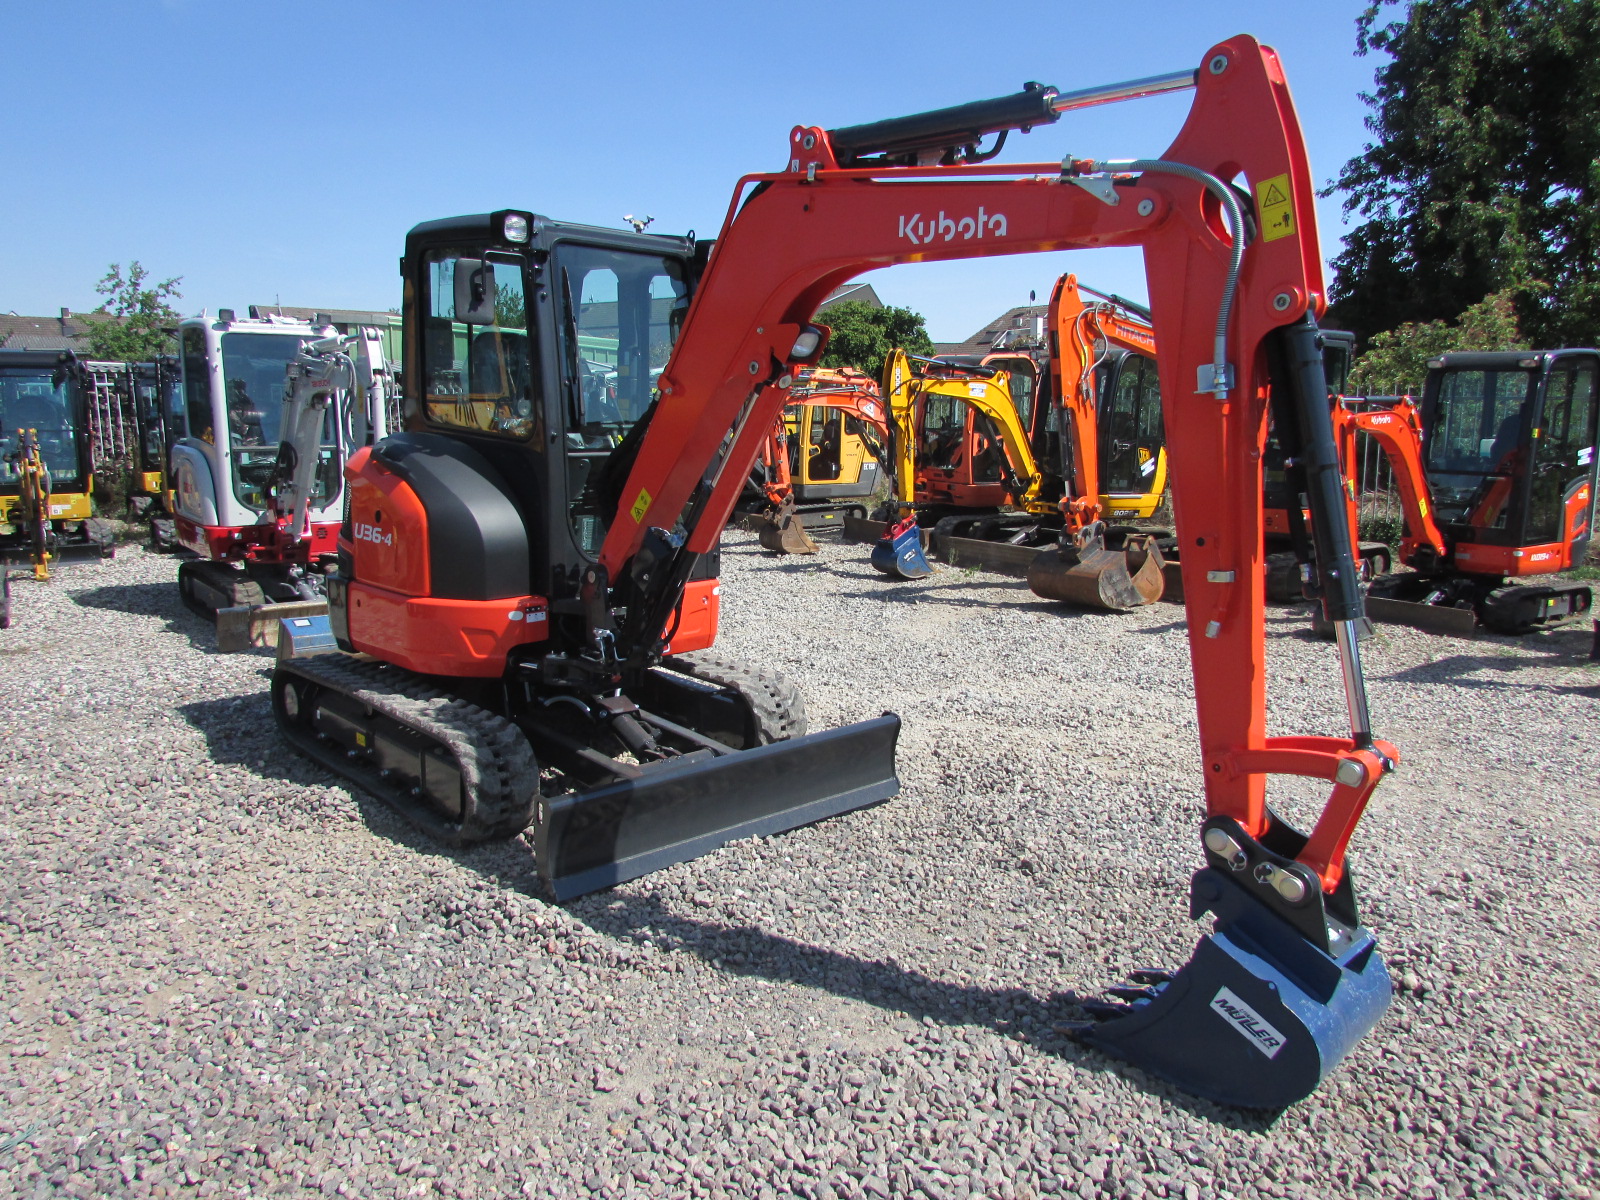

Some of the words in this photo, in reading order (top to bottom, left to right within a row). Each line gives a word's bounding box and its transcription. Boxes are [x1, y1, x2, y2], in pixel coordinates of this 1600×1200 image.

[898, 206, 1007, 245] Kubota
[1115, 324, 1155, 347] HITACH
[1371, 415, 1391, 425] Kubota
[354, 522, 392, 547] U36-4
